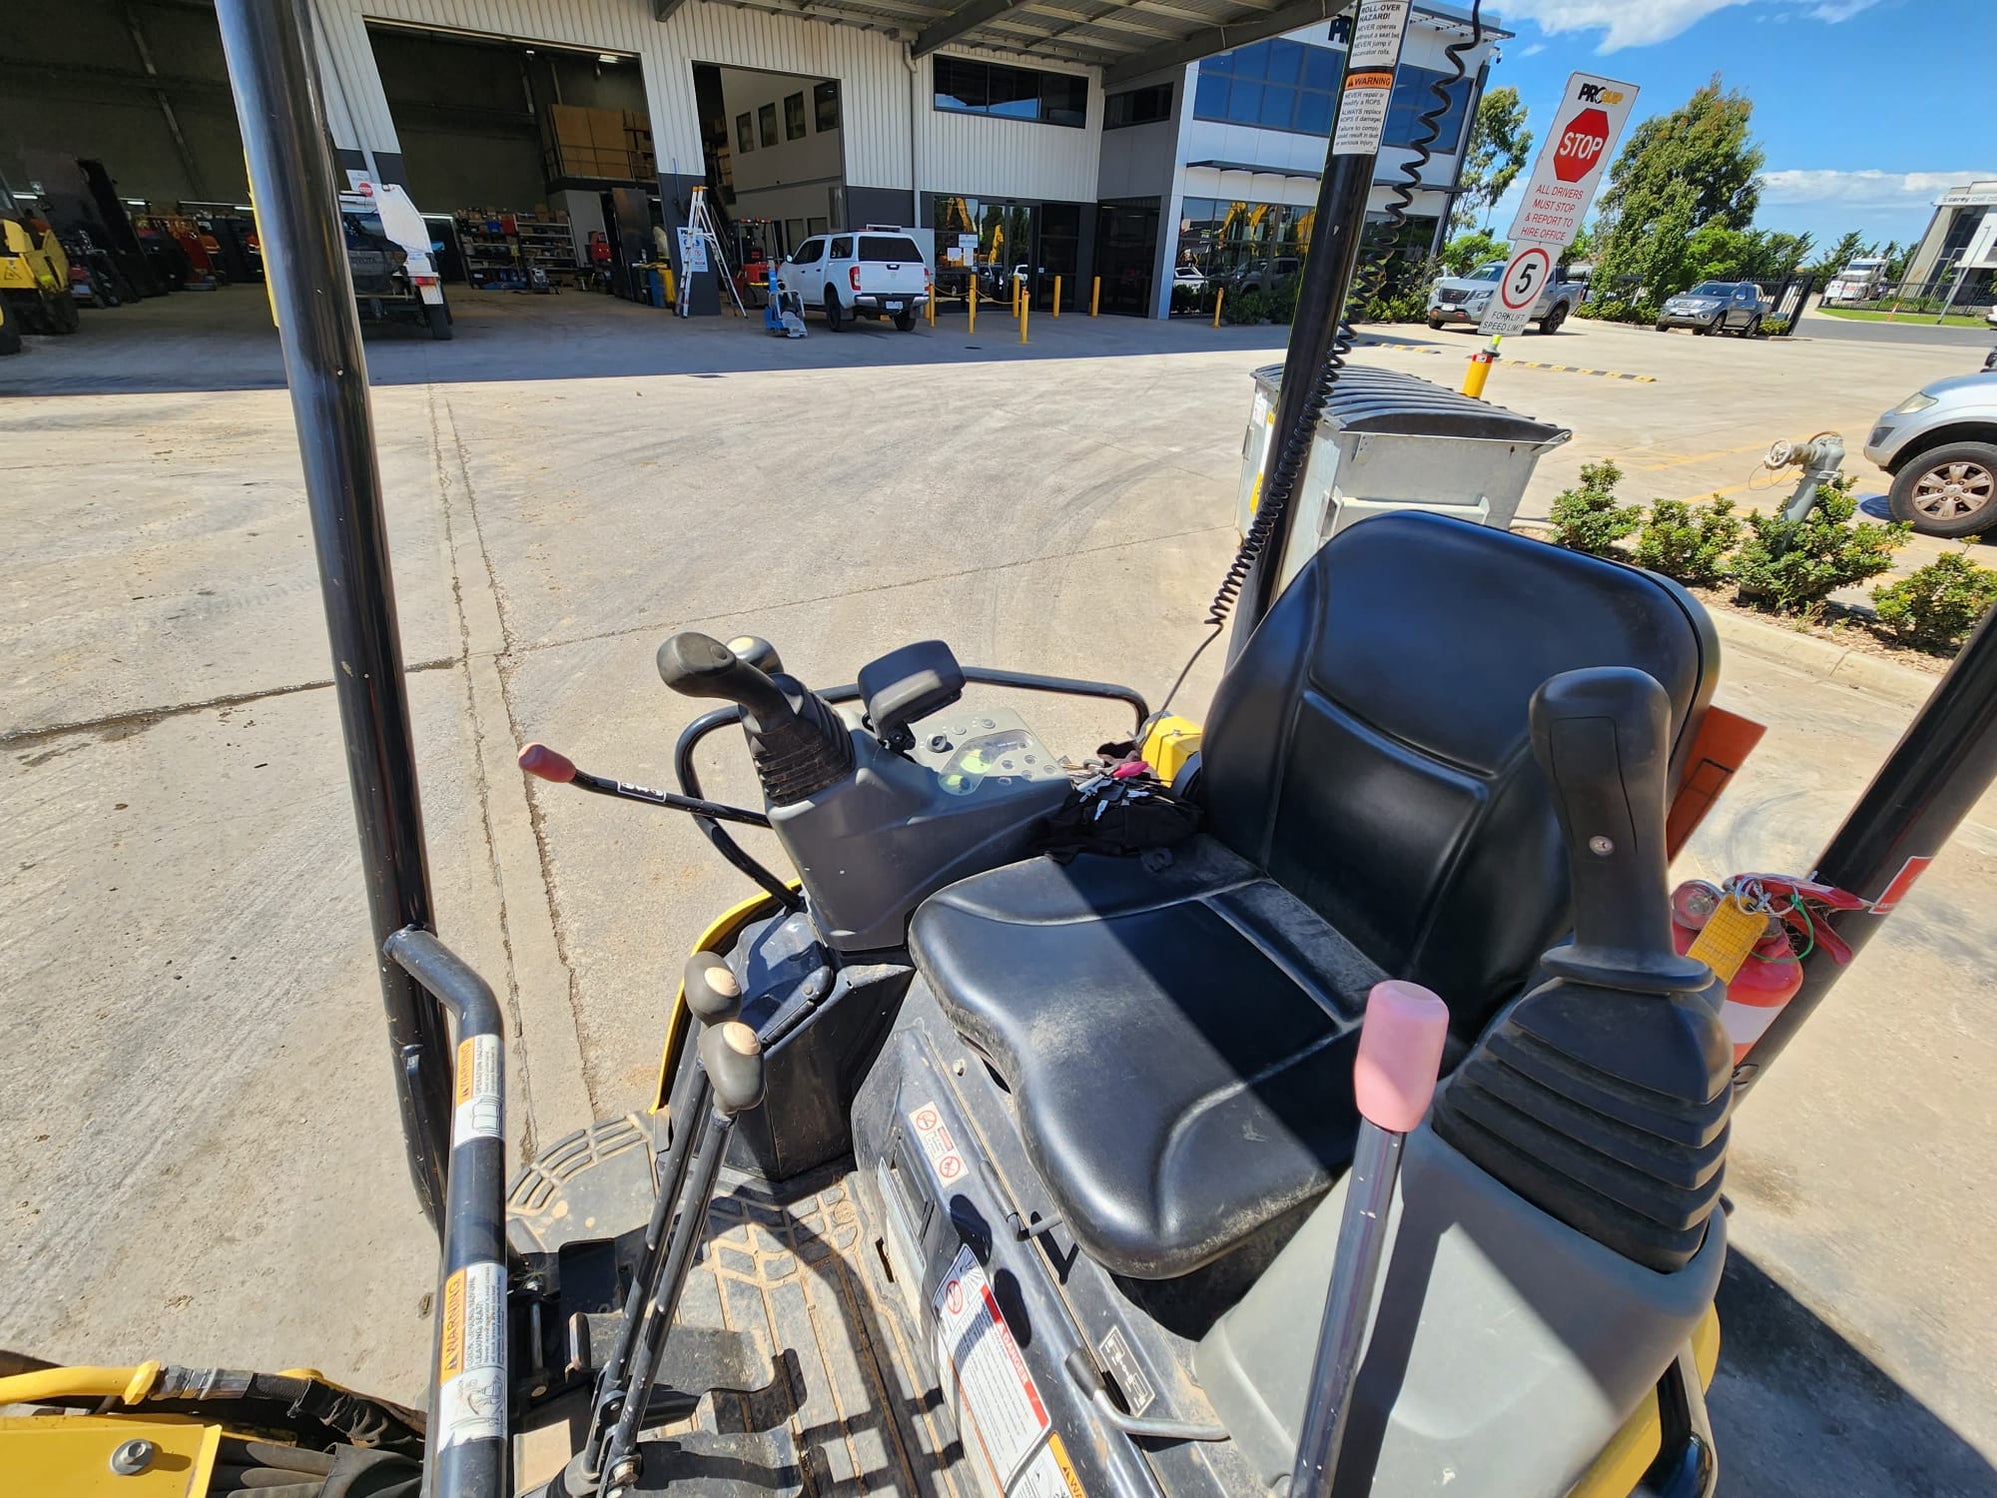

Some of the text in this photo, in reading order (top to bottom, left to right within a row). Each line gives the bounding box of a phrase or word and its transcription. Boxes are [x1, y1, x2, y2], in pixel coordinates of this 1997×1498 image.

[1355, 76, 1390, 86] WARNING
[1560, 132, 1603, 160] STOP
[1536, 184, 1583, 200] ALL DRIVERS
[1532, 198, 1576, 213] MUST STOP
[1532, 213, 1562, 226] REPORT
[1563, 217, 1573, 227] TO
[1521, 227, 1566, 240] HIRE OFFICE
[1515, 264, 1537, 294] 5
[1492, 311, 1525, 322] FORKLIFT
[1483, 321, 1506, 331] SPEED
[446, 1279, 460, 1358] WARNING
[1003, 1333, 1029, 1384] DANGER
